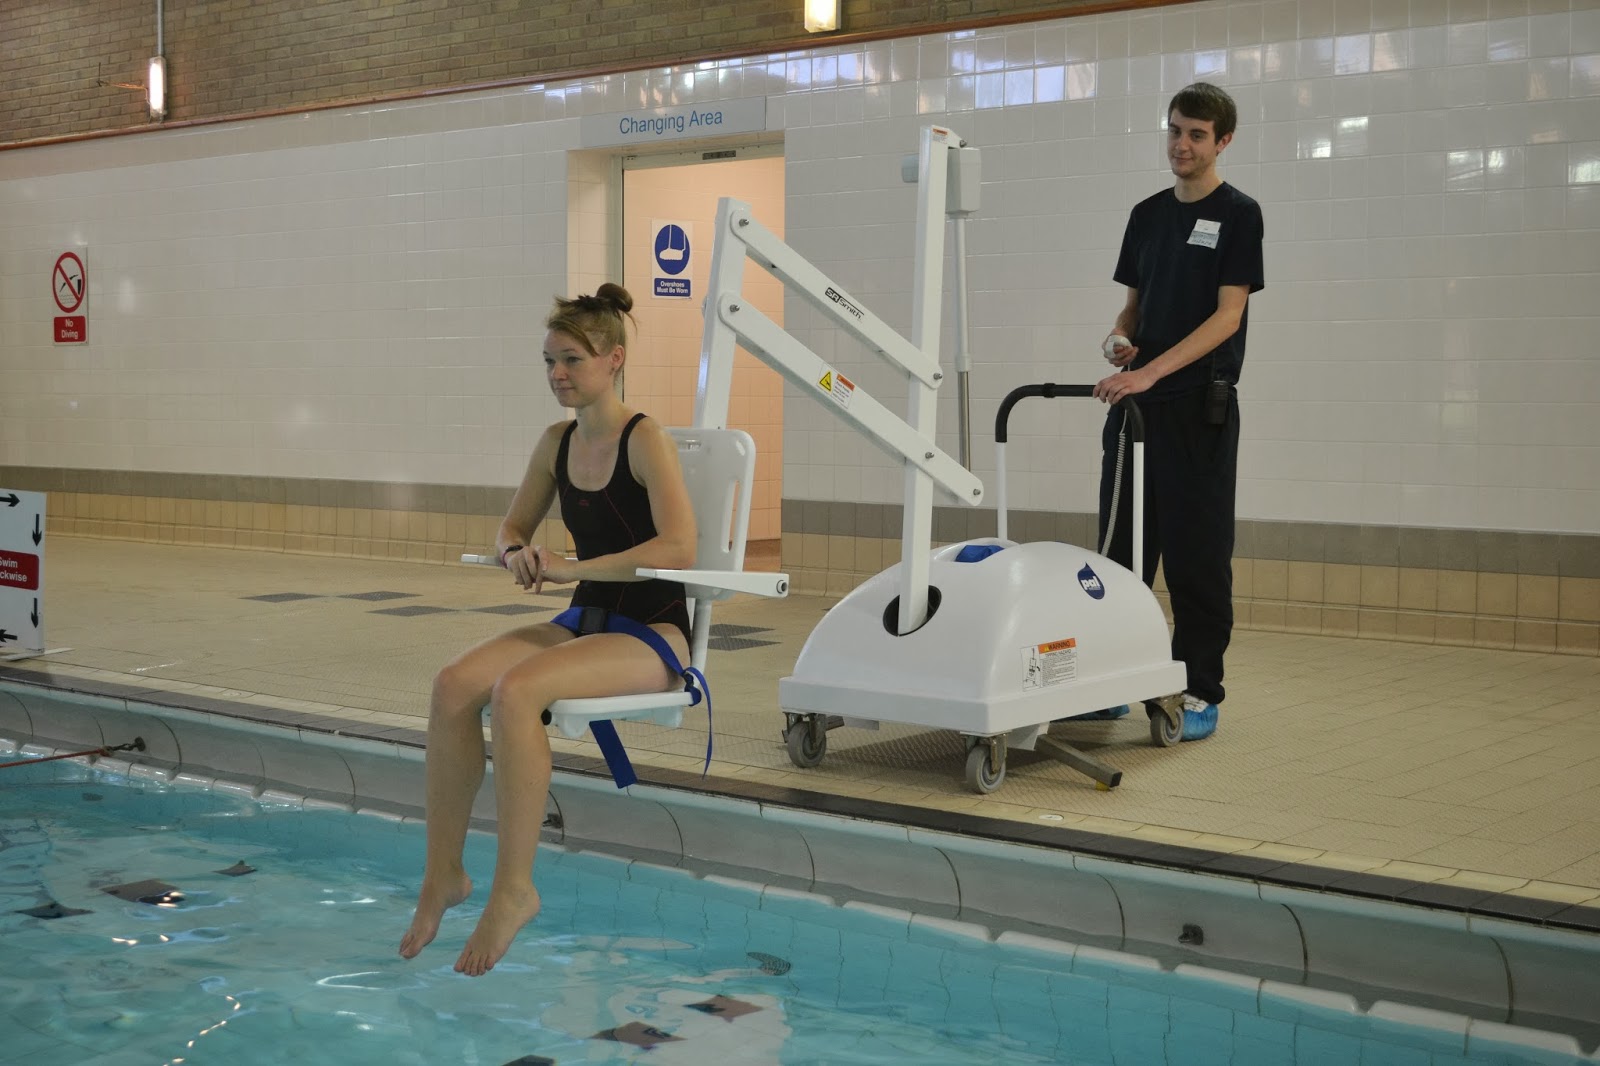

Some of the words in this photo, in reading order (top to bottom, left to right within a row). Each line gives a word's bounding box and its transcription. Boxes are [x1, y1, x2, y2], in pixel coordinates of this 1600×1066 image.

[620, 115, 684, 135] Changing
[689, 110, 723, 127] Area
[65, 318, 74, 328] No
[61, 329, 79, 340] Diving
[0, 556, 18, 568] Swim
[0, 570, 28, 582] ckwise
[1080, 575, 1101, 591] pal
[1048, 640, 1071, 651] WARNING
